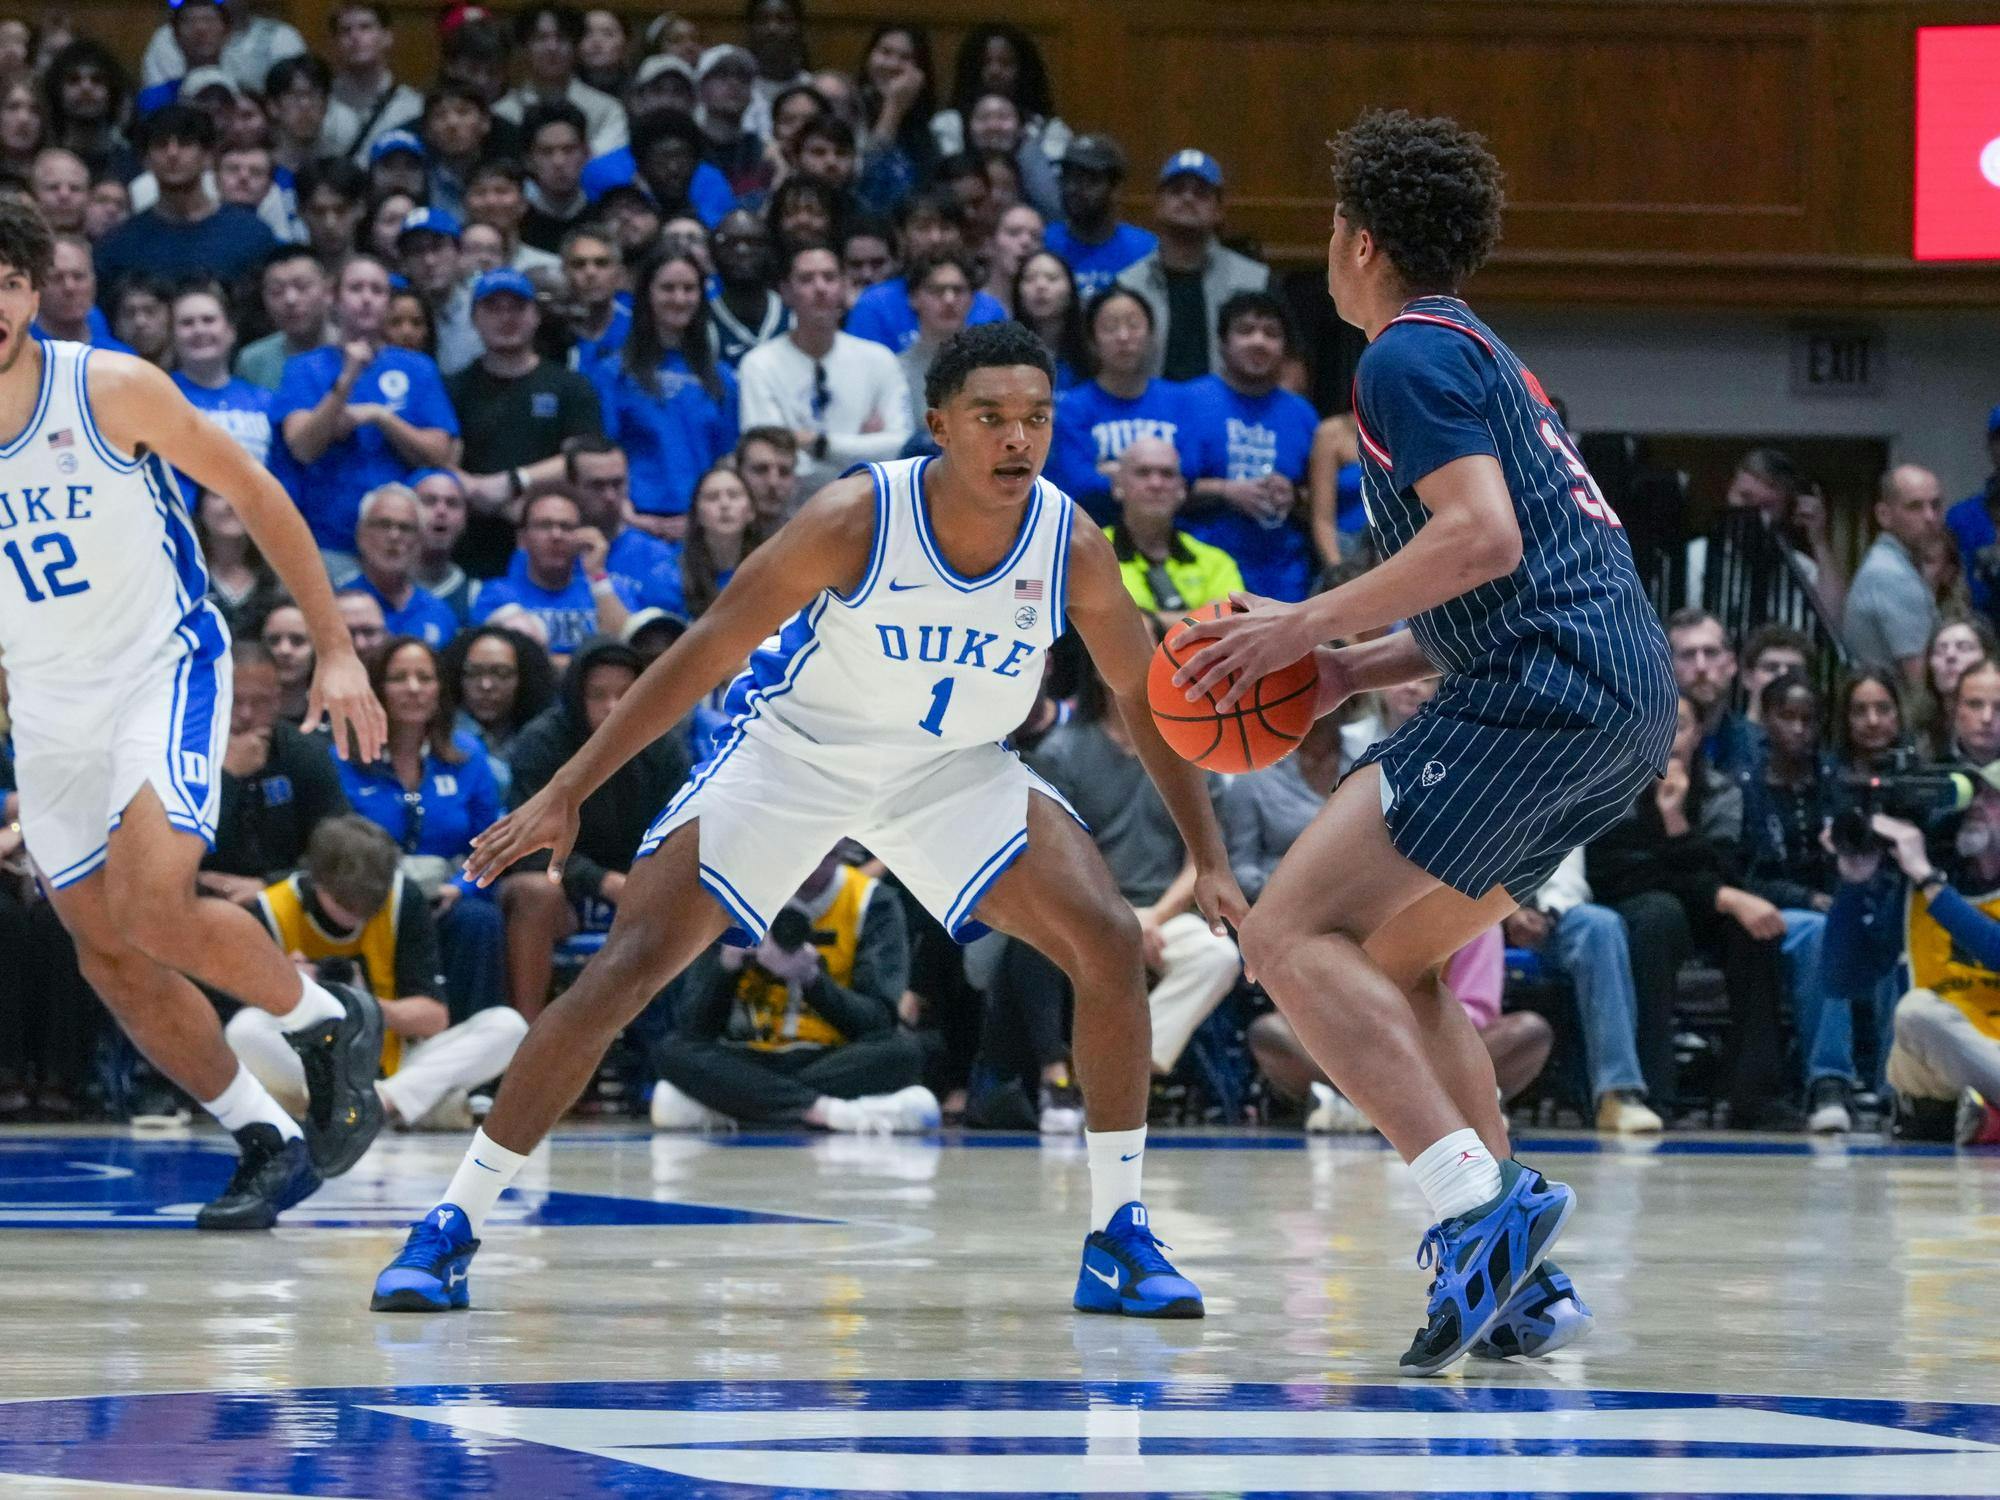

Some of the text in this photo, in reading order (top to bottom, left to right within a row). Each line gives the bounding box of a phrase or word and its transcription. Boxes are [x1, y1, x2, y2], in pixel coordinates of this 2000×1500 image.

[1808, 336, 1869, 383] EXIT
[3, 531, 91, 602] 12
[875, 623, 1036, 678] DUKE
[918, 677, 955, 738] 1
[180, 750, 208, 786] D
